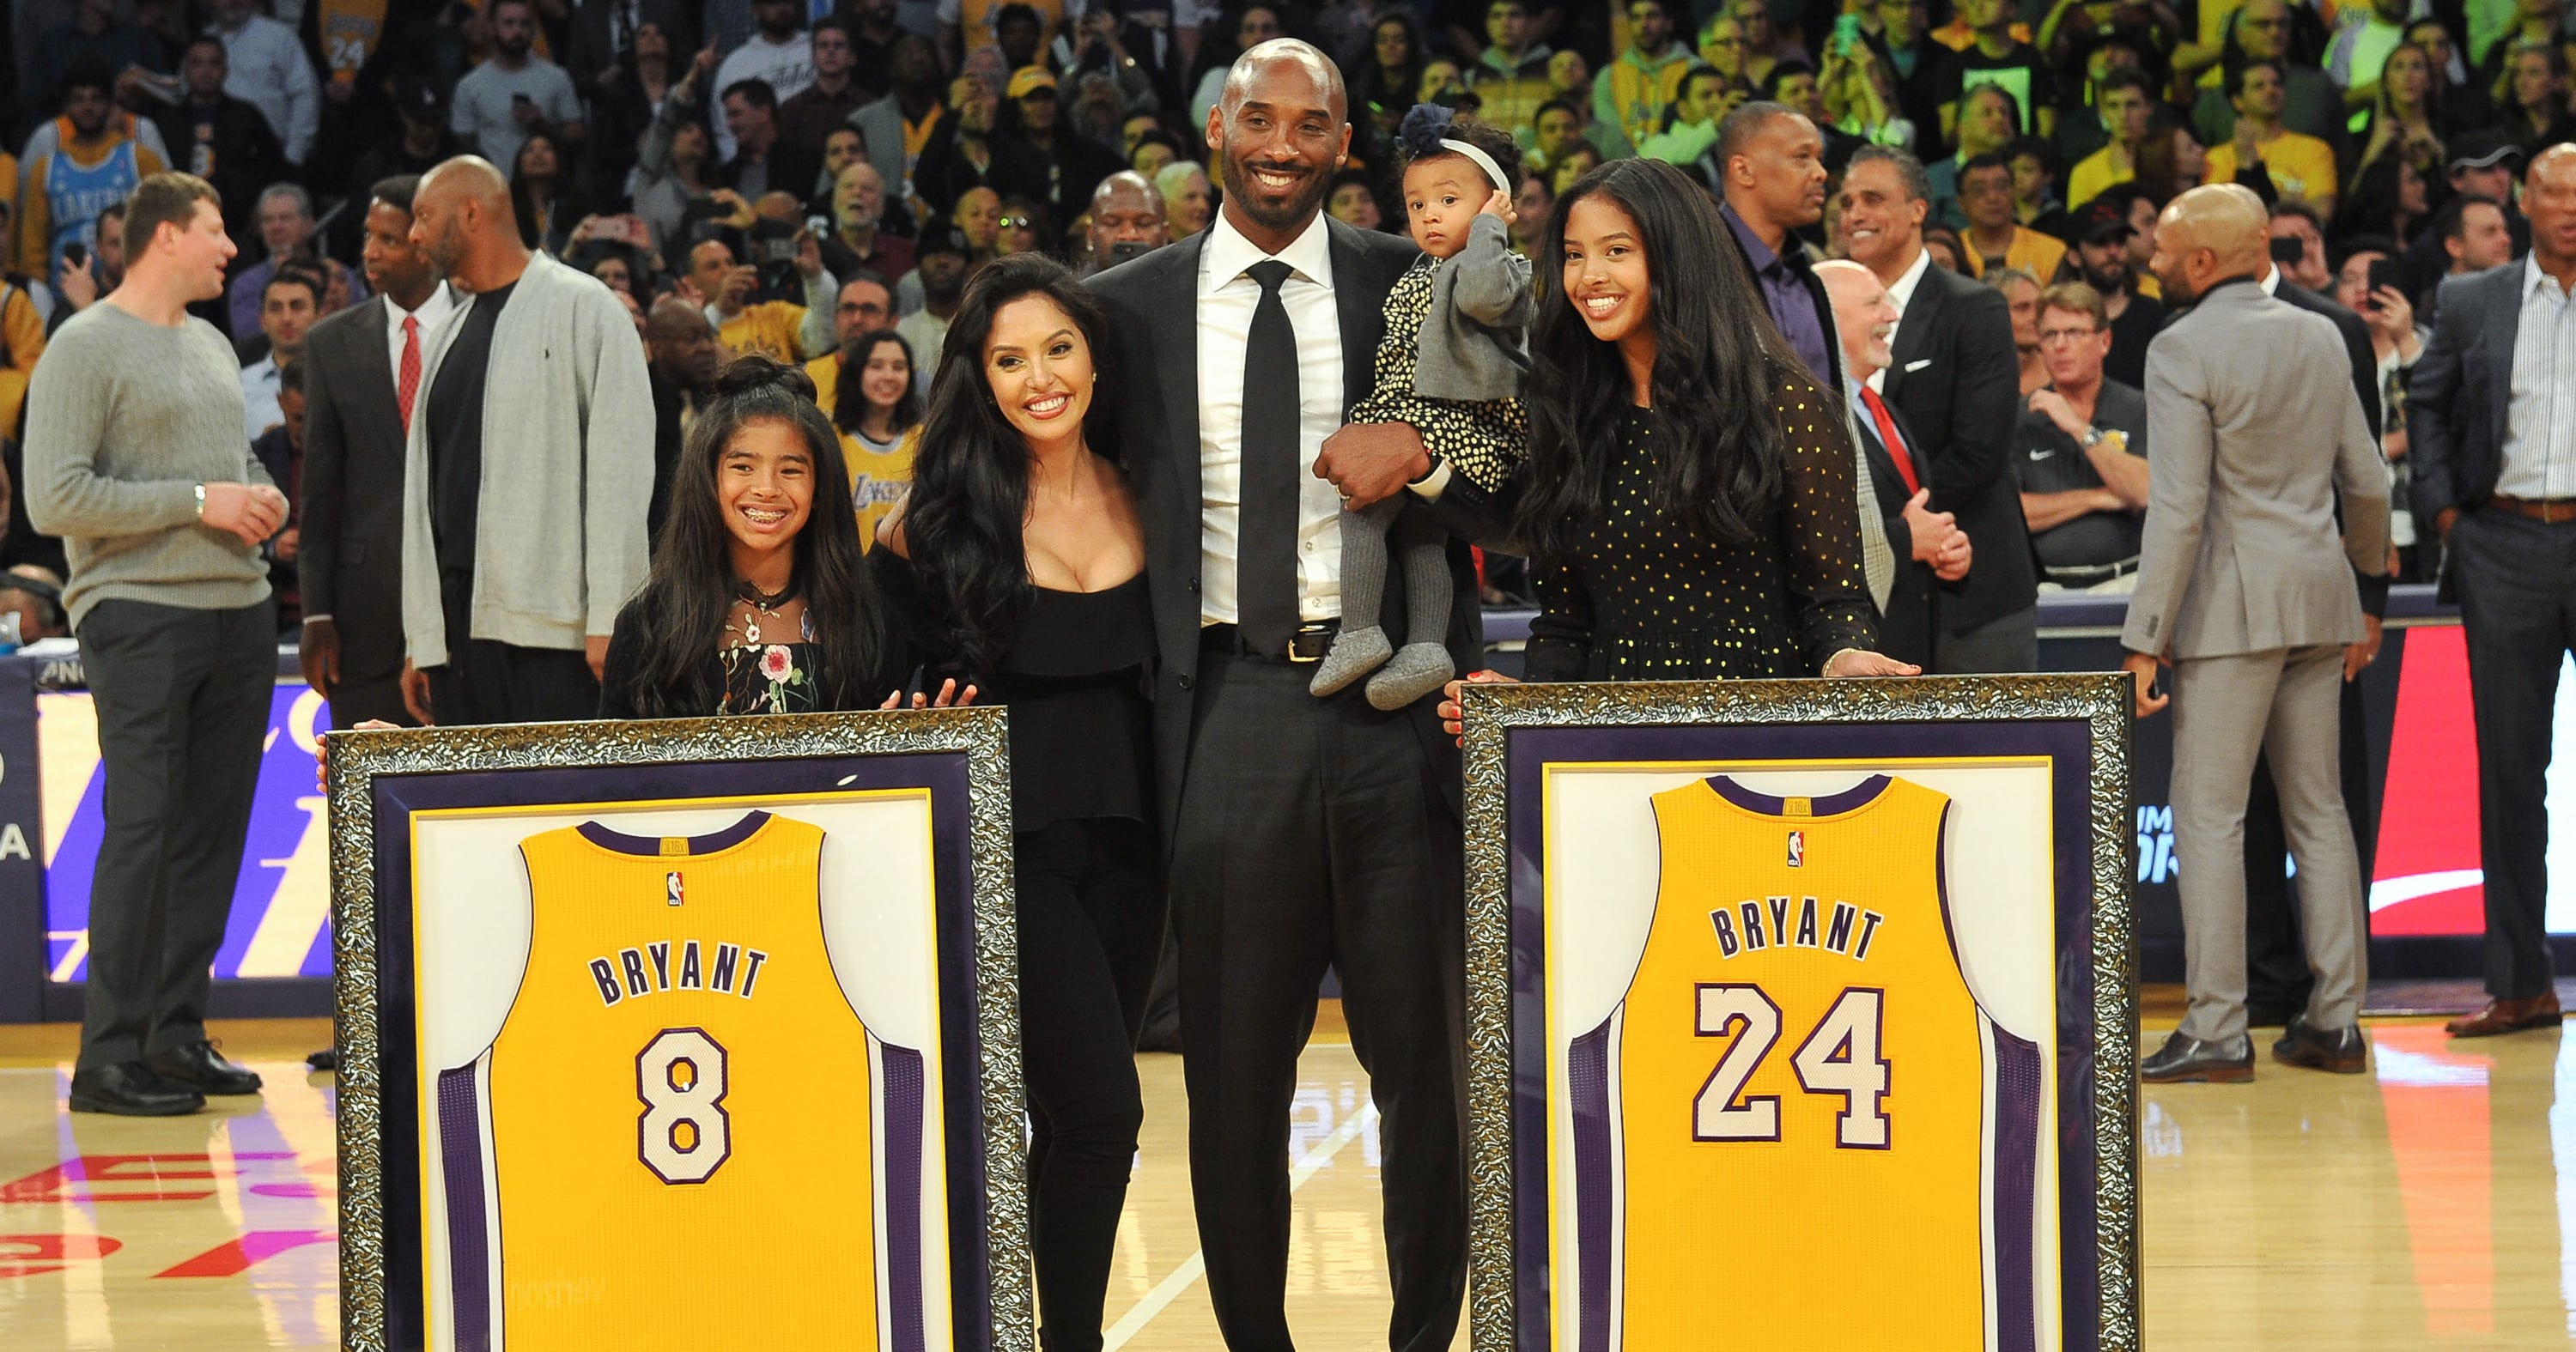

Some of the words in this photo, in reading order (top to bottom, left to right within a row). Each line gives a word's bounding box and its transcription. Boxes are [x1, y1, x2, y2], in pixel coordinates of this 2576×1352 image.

[588, 940, 769, 1007] BRYANT
[1710, 896, 1884, 961] BRYANT
[635, 1027, 732, 1185] 8
[1692, 982, 1892, 1151] 24
